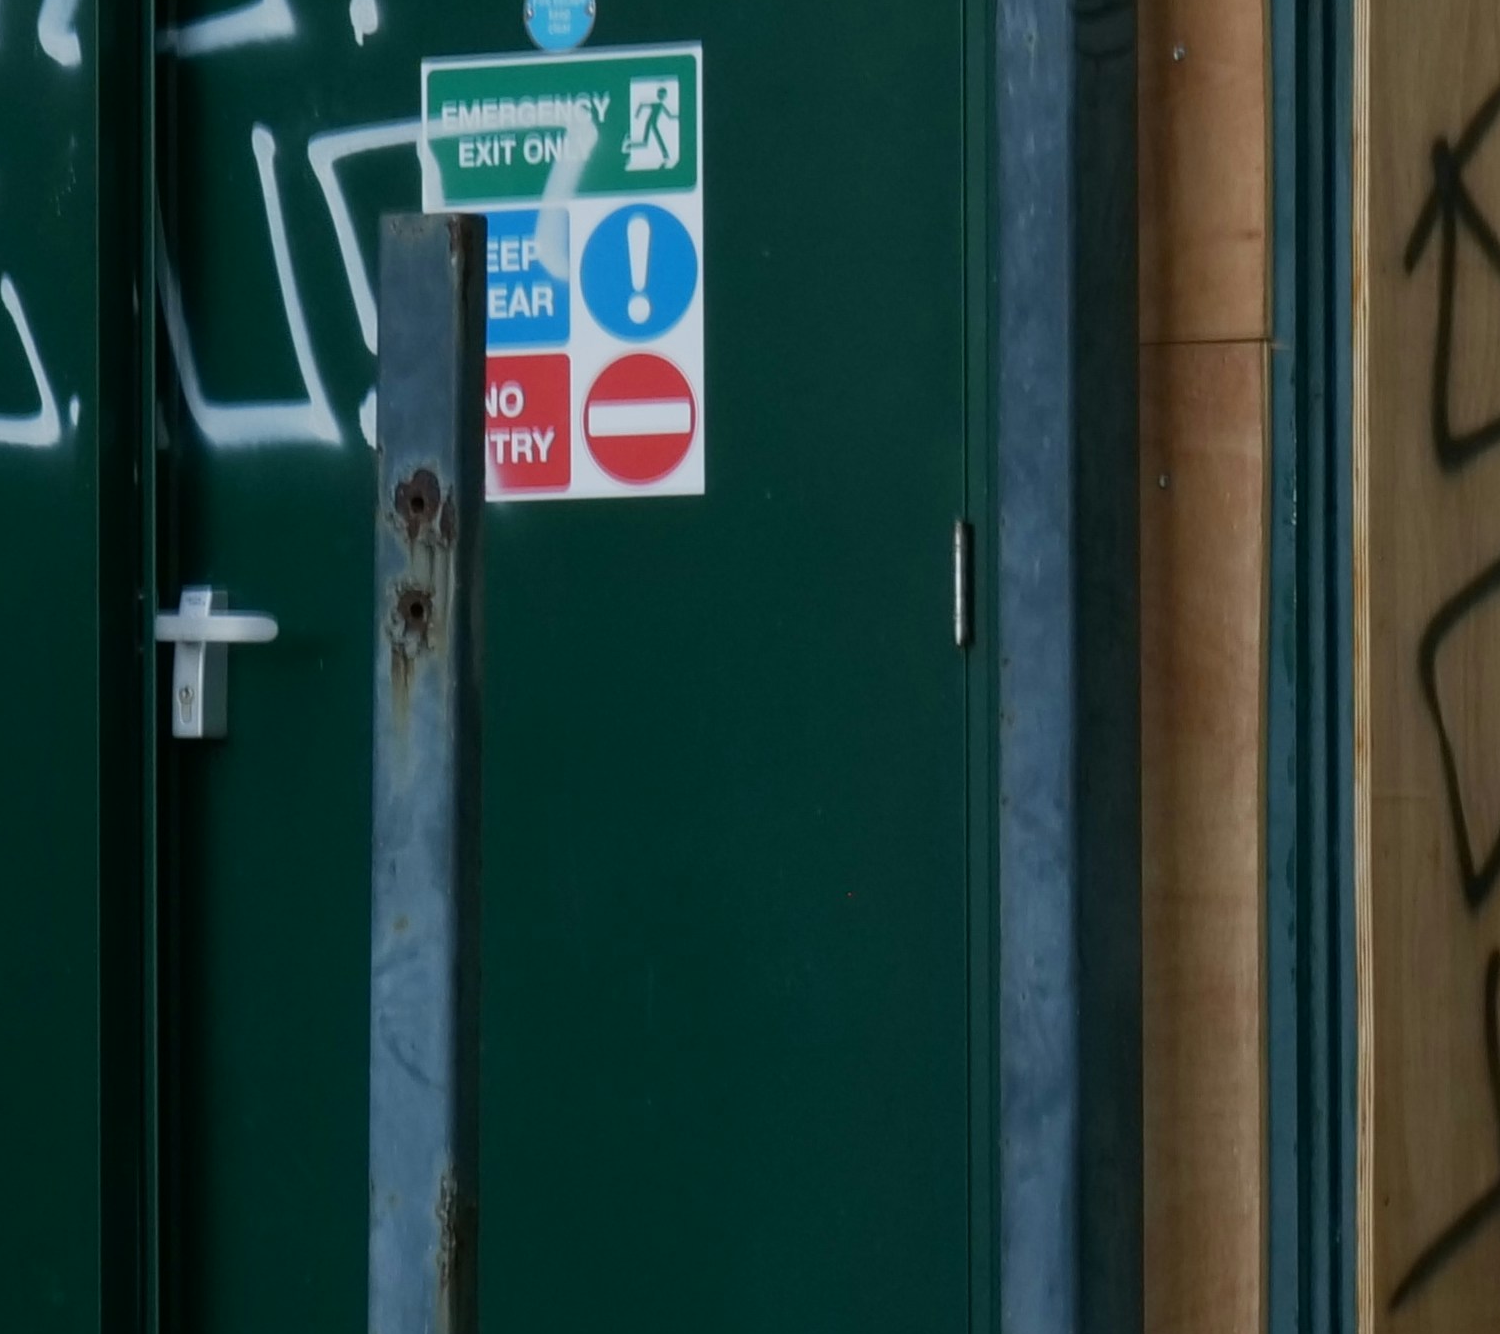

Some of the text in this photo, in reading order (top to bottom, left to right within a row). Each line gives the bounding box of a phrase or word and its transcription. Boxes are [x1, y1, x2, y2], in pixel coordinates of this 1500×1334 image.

[441, 92, 610, 130] EMERGENCY
[459, 134, 516, 167] EXIT
[487, 236, 542, 273] EEP
[488, 282, 554, 319] EAR
[486, 426, 555, 464] TRY
